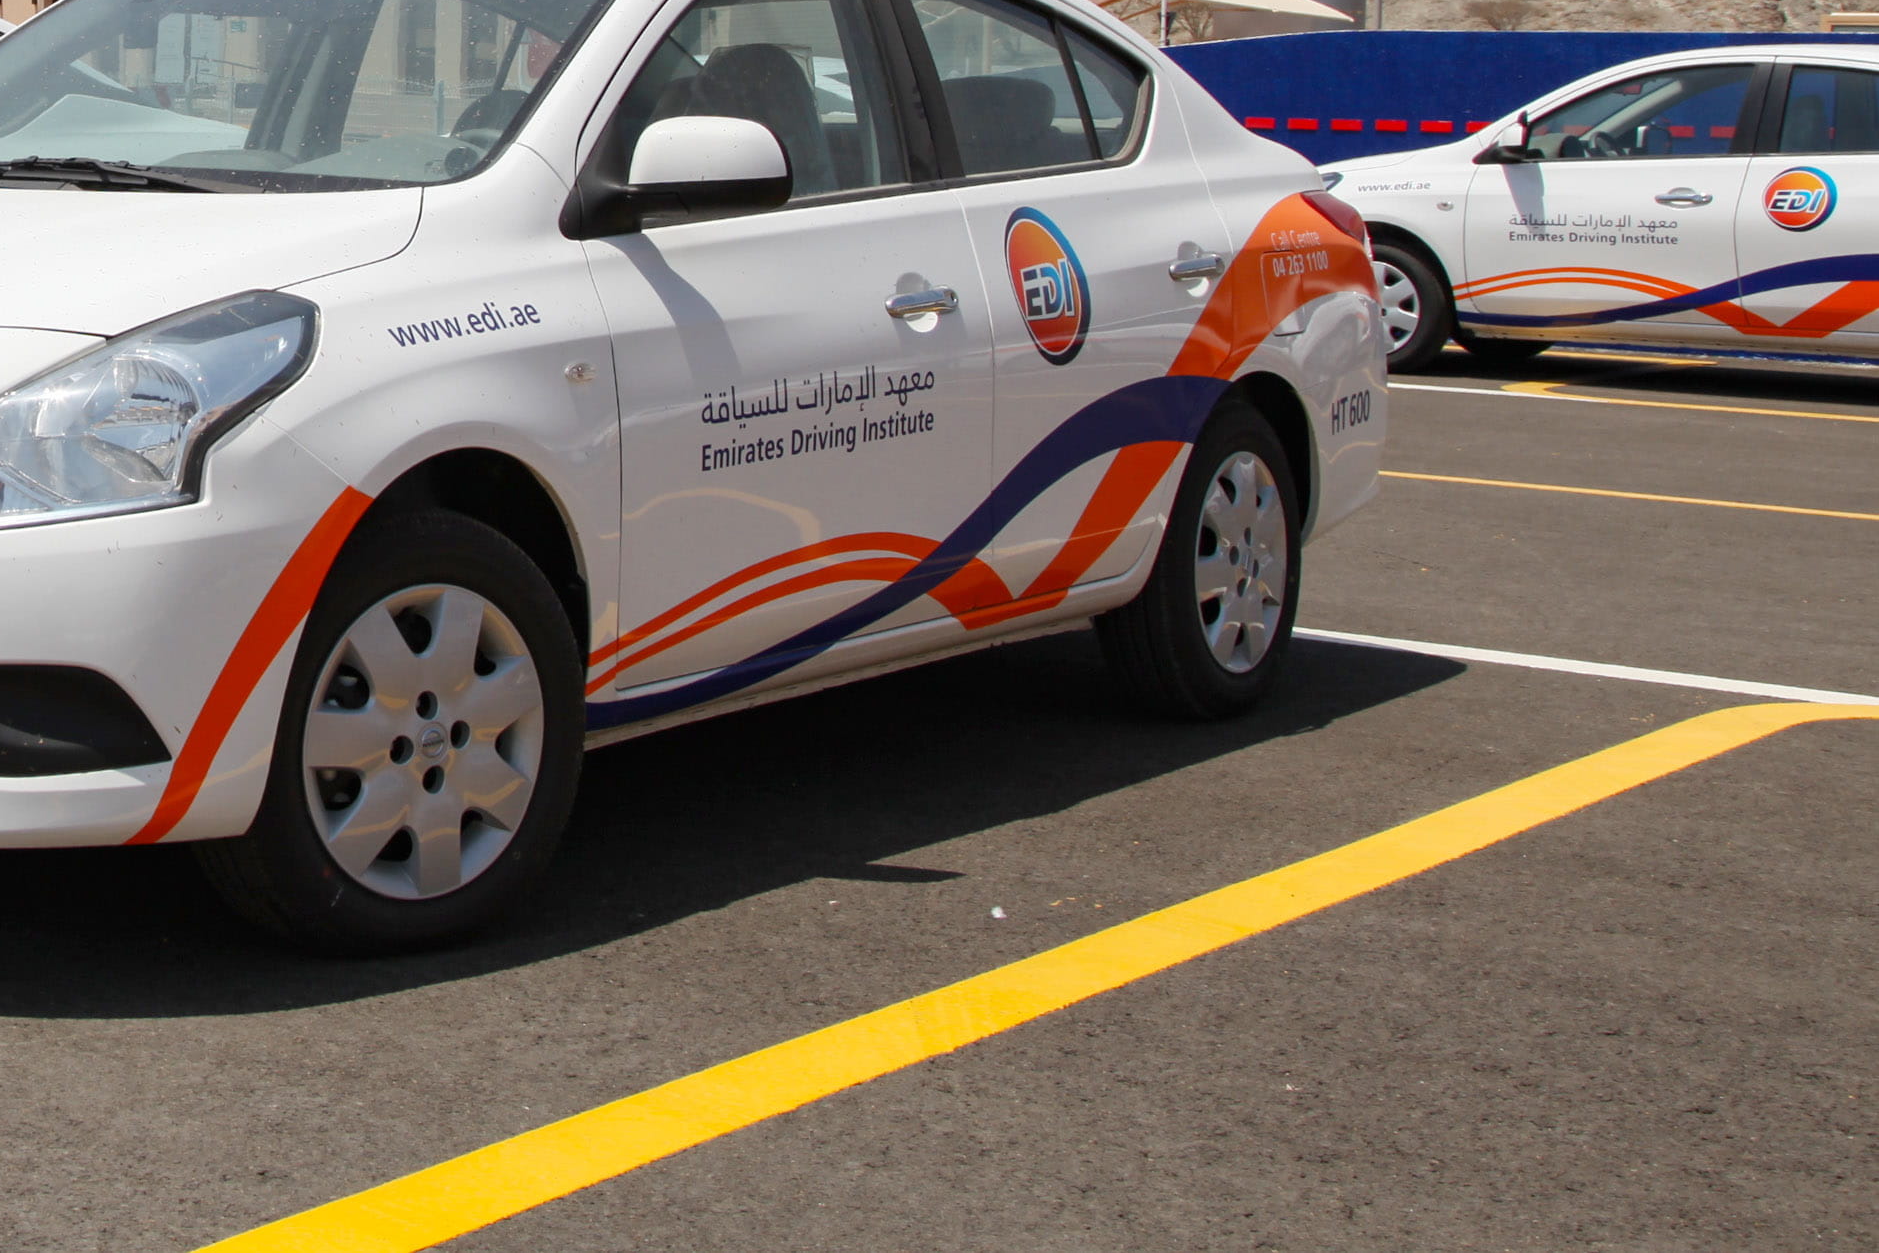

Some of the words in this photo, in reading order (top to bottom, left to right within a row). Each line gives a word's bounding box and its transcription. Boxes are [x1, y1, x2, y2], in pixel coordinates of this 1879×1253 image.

[1358, 181, 1431, 192] www.edi.ae
[1768, 189, 1826, 213] EDI
[1509, 213, 1567, 229] للسياقة
[1637, 219, 1678, 233] معهد
[1271, 230, 1288, 252] Call
[1289, 229, 1320, 248] Centre
[1509, 231, 1564, 242] Emirates
[1569, 232, 1617, 245] Driving
[1621, 233, 1678, 245] Institute
[1272, 257, 1286, 277] 04
[1287, 253, 1305, 274] 263
[1306, 250, 1329, 272] 1100
[1020, 256, 1077, 322] EDI
[387, 301, 541, 347] www.edi.ae
[796, 364, 876, 414] الإمارات
[884, 366, 935, 406] معهد
[701, 378, 788, 430] للسياقة
[1331, 397, 1348, 435] HT
[1349, 389, 1370, 427] 600
[701, 434, 784, 472] Emirates
[790, 418, 857, 456] Driving
[862, 408, 935, 444] Institute
